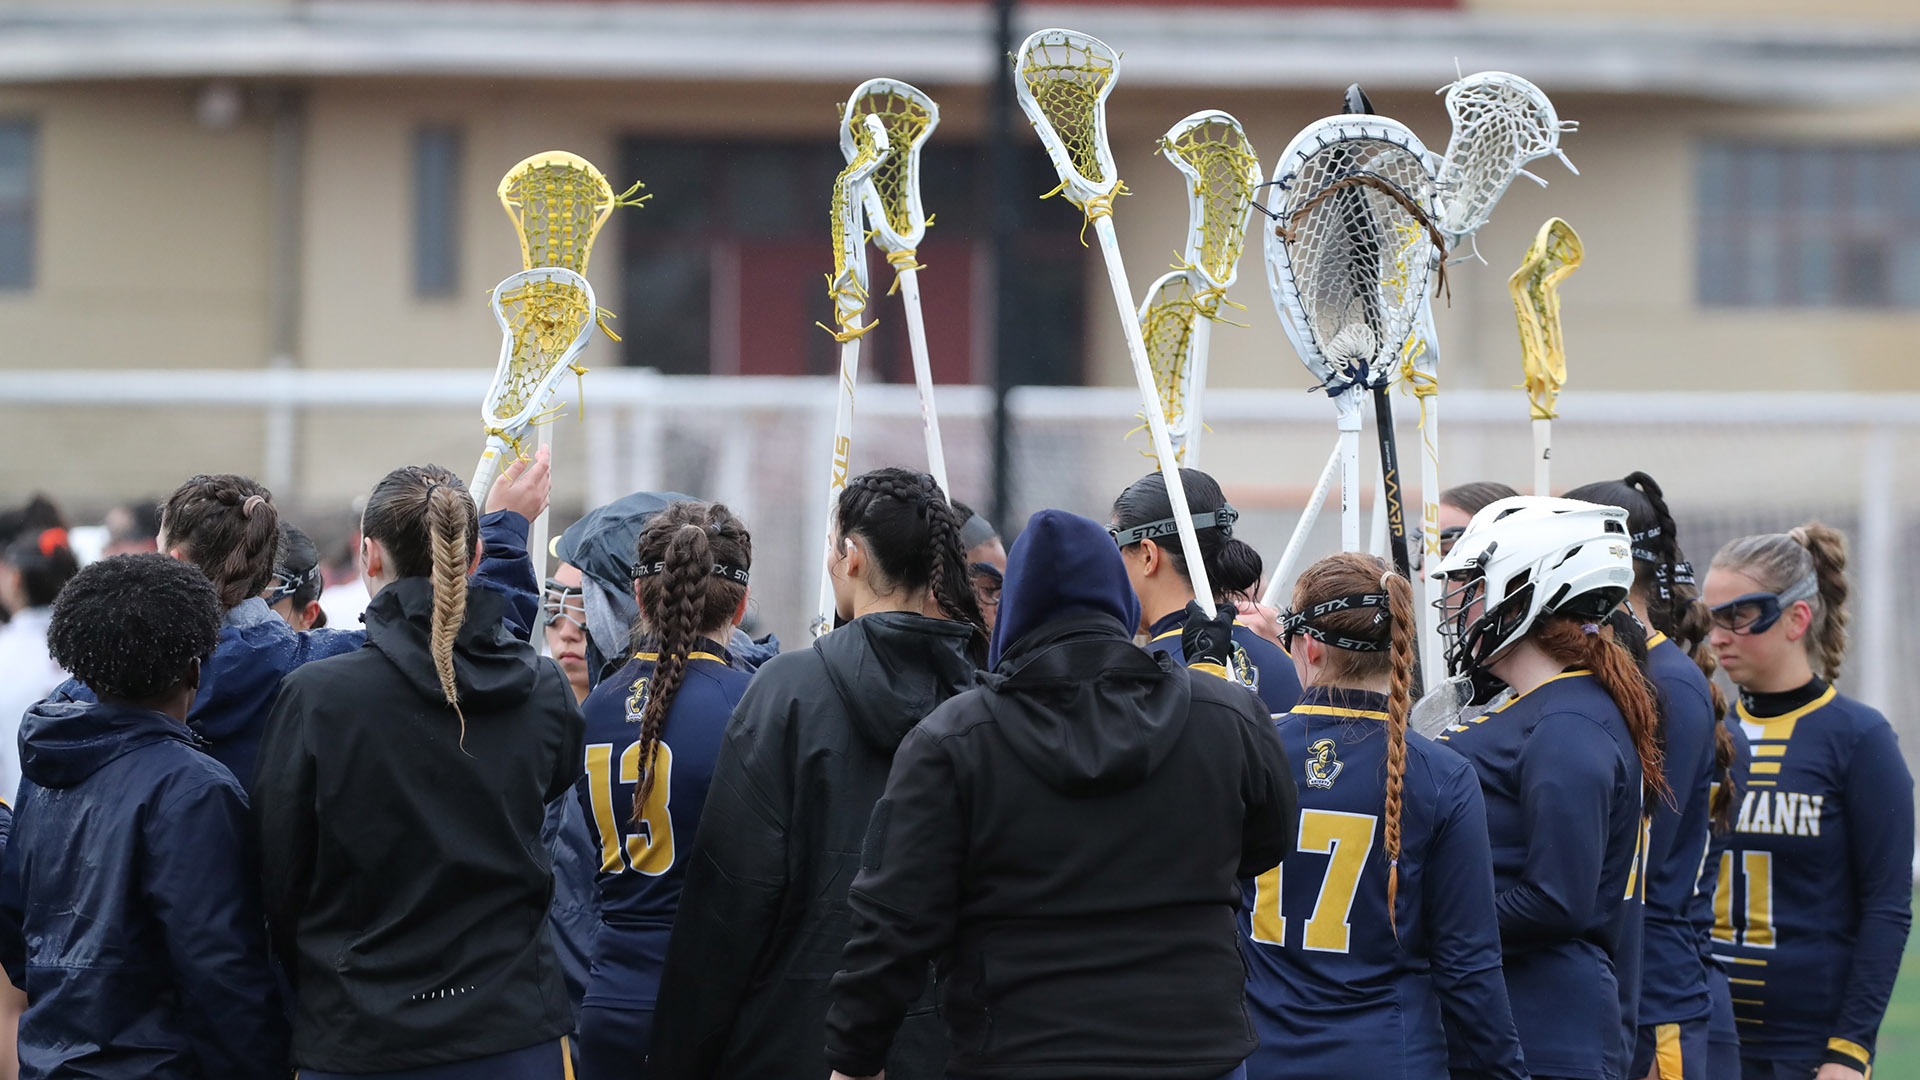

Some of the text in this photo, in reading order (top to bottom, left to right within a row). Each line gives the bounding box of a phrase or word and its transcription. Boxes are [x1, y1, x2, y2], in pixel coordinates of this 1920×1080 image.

[832, 434, 850, 489] STX
[1132, 523, 1164, 540] STX
[1385, 469, 1404, 537] WARP
[1424, 501, 1440, 558] STX
[1283, 611, 1306, 631] STX
[1314, 597, 1349, 617] STX
[1296, 625, 1326, 642] STX
[1337, 636, 1377, 651] STX
[584, 739, 676, 877] 13
[1250, 808, 1378, 954] 17
[1709, 849, 1777, 950] 11
